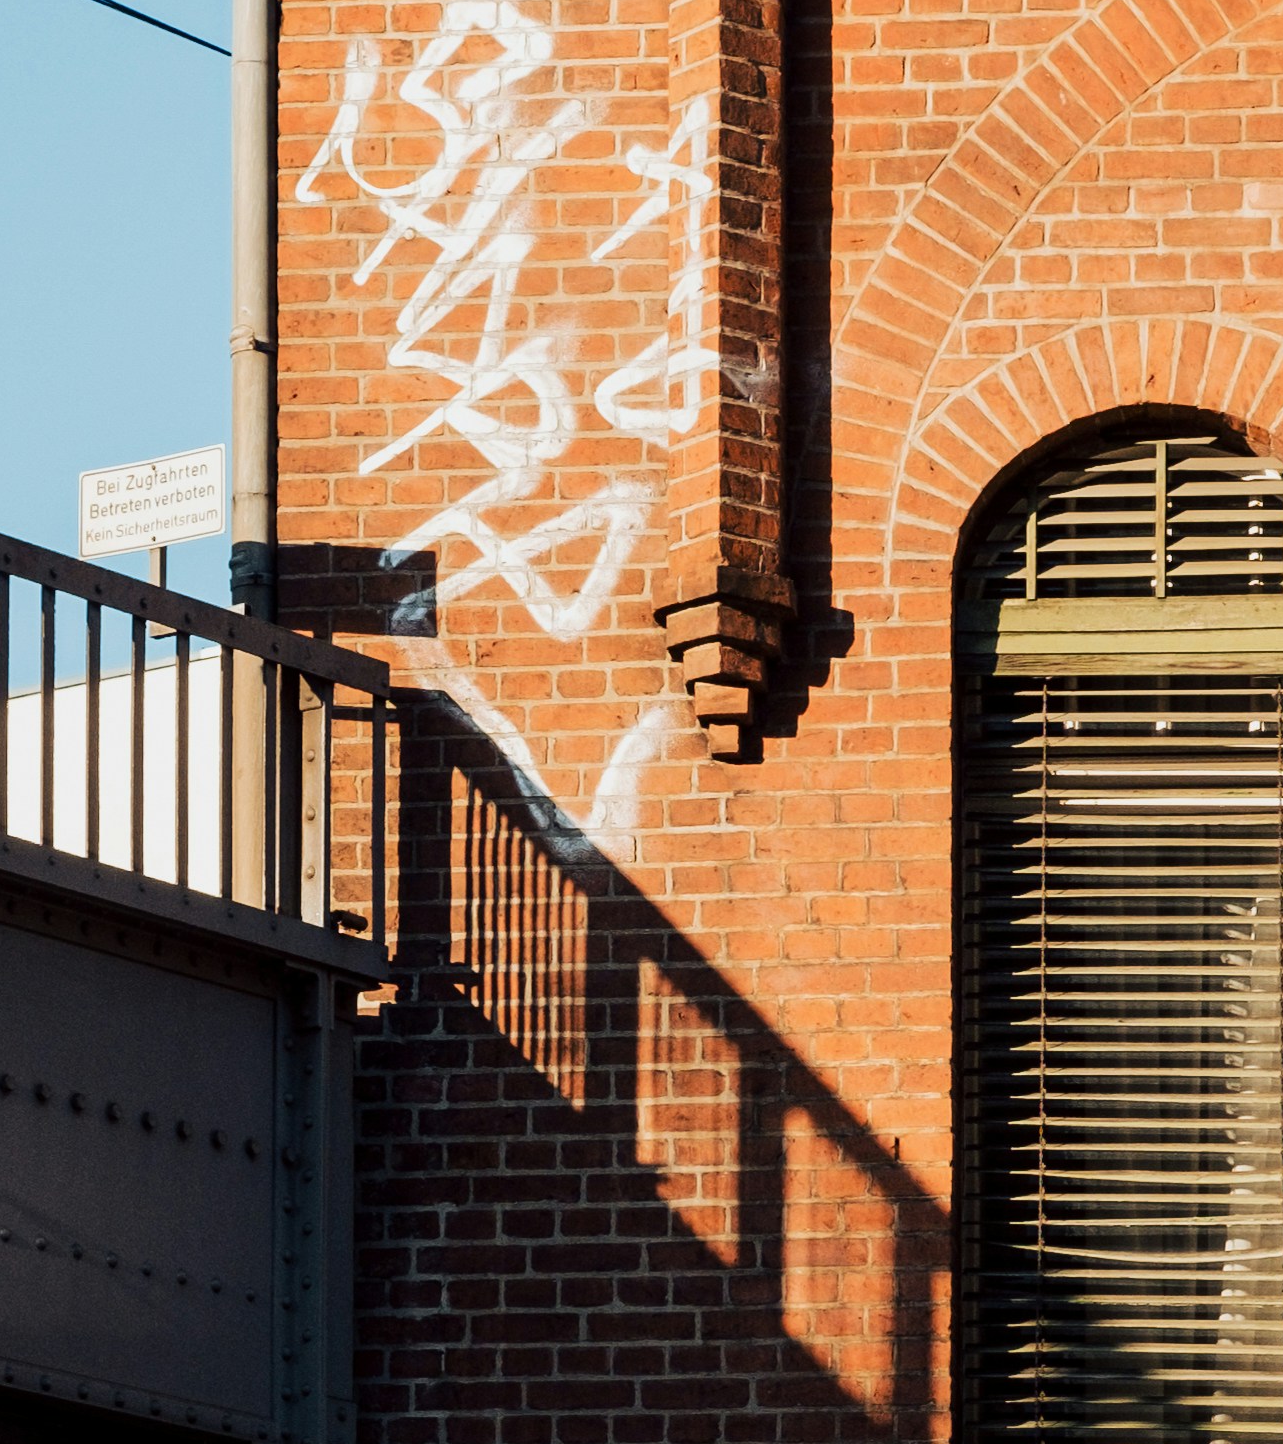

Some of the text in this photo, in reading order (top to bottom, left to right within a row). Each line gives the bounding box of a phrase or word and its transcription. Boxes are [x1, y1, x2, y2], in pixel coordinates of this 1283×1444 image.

[96, 463, 209, 496] Bei Zugfahrten
[89, 484, 215, 520] Betreten verboten
[85, 508, 219, 544] Kein Sicherheitsraum
